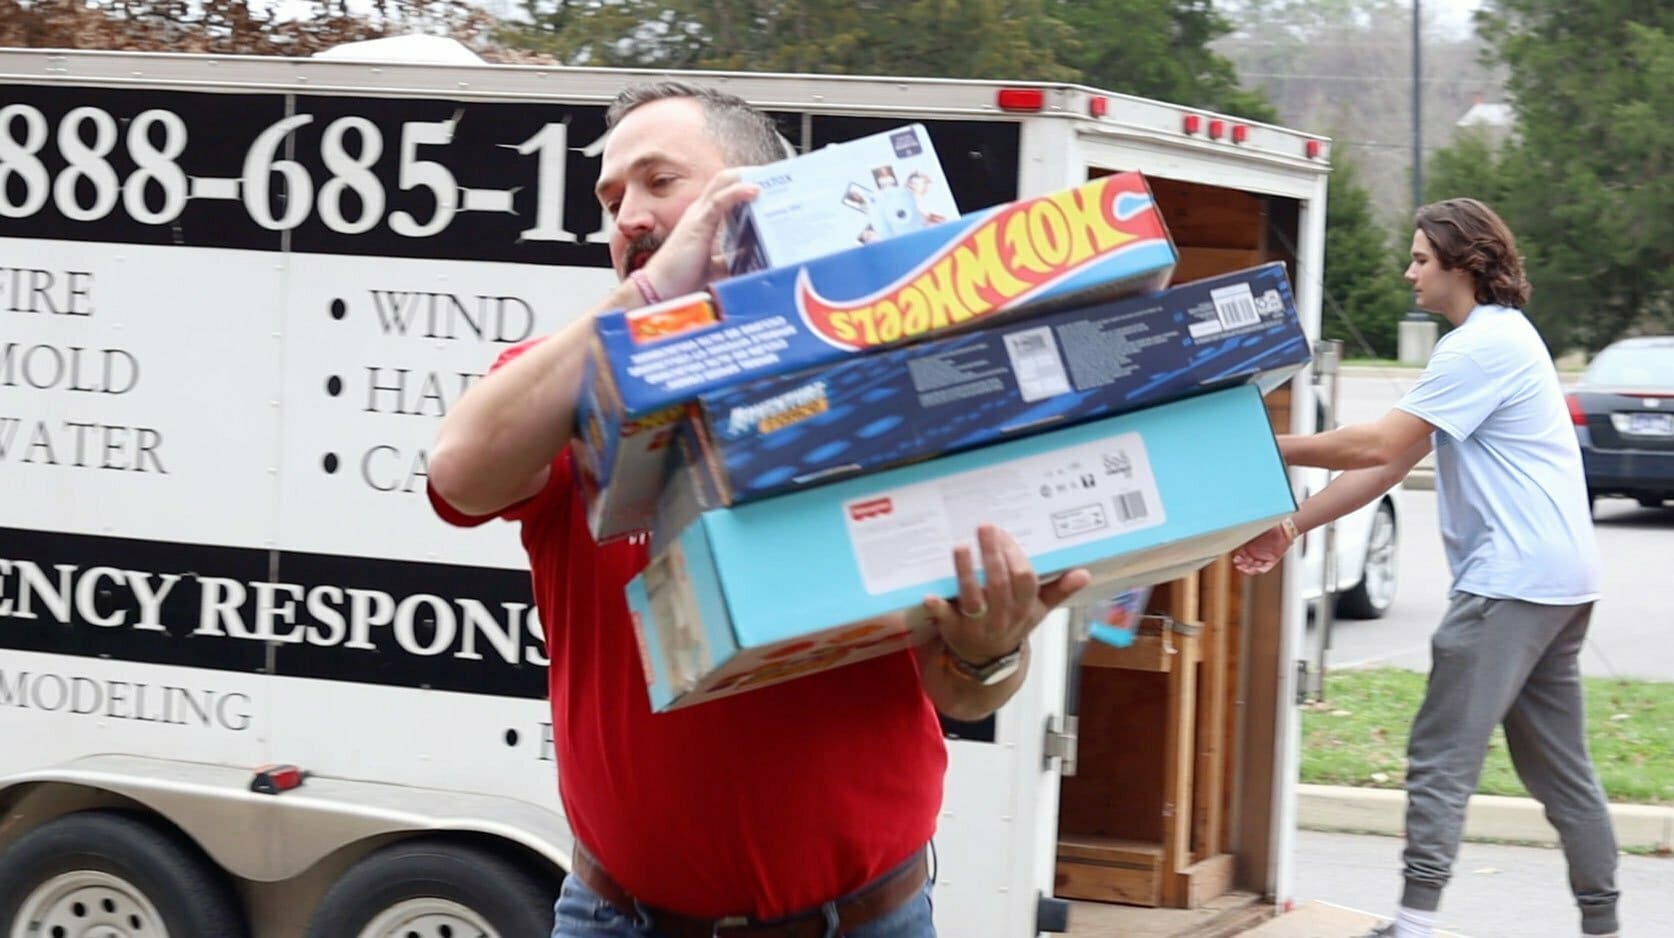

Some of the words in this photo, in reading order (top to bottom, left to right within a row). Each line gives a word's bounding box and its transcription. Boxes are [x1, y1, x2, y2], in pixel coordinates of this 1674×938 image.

[1004, 179, 1142, 273] HOT
[0, 266, 95, 317] IRE
[368, 289, 535, 344] WIND
[0, 558, 182, 631] NCY
